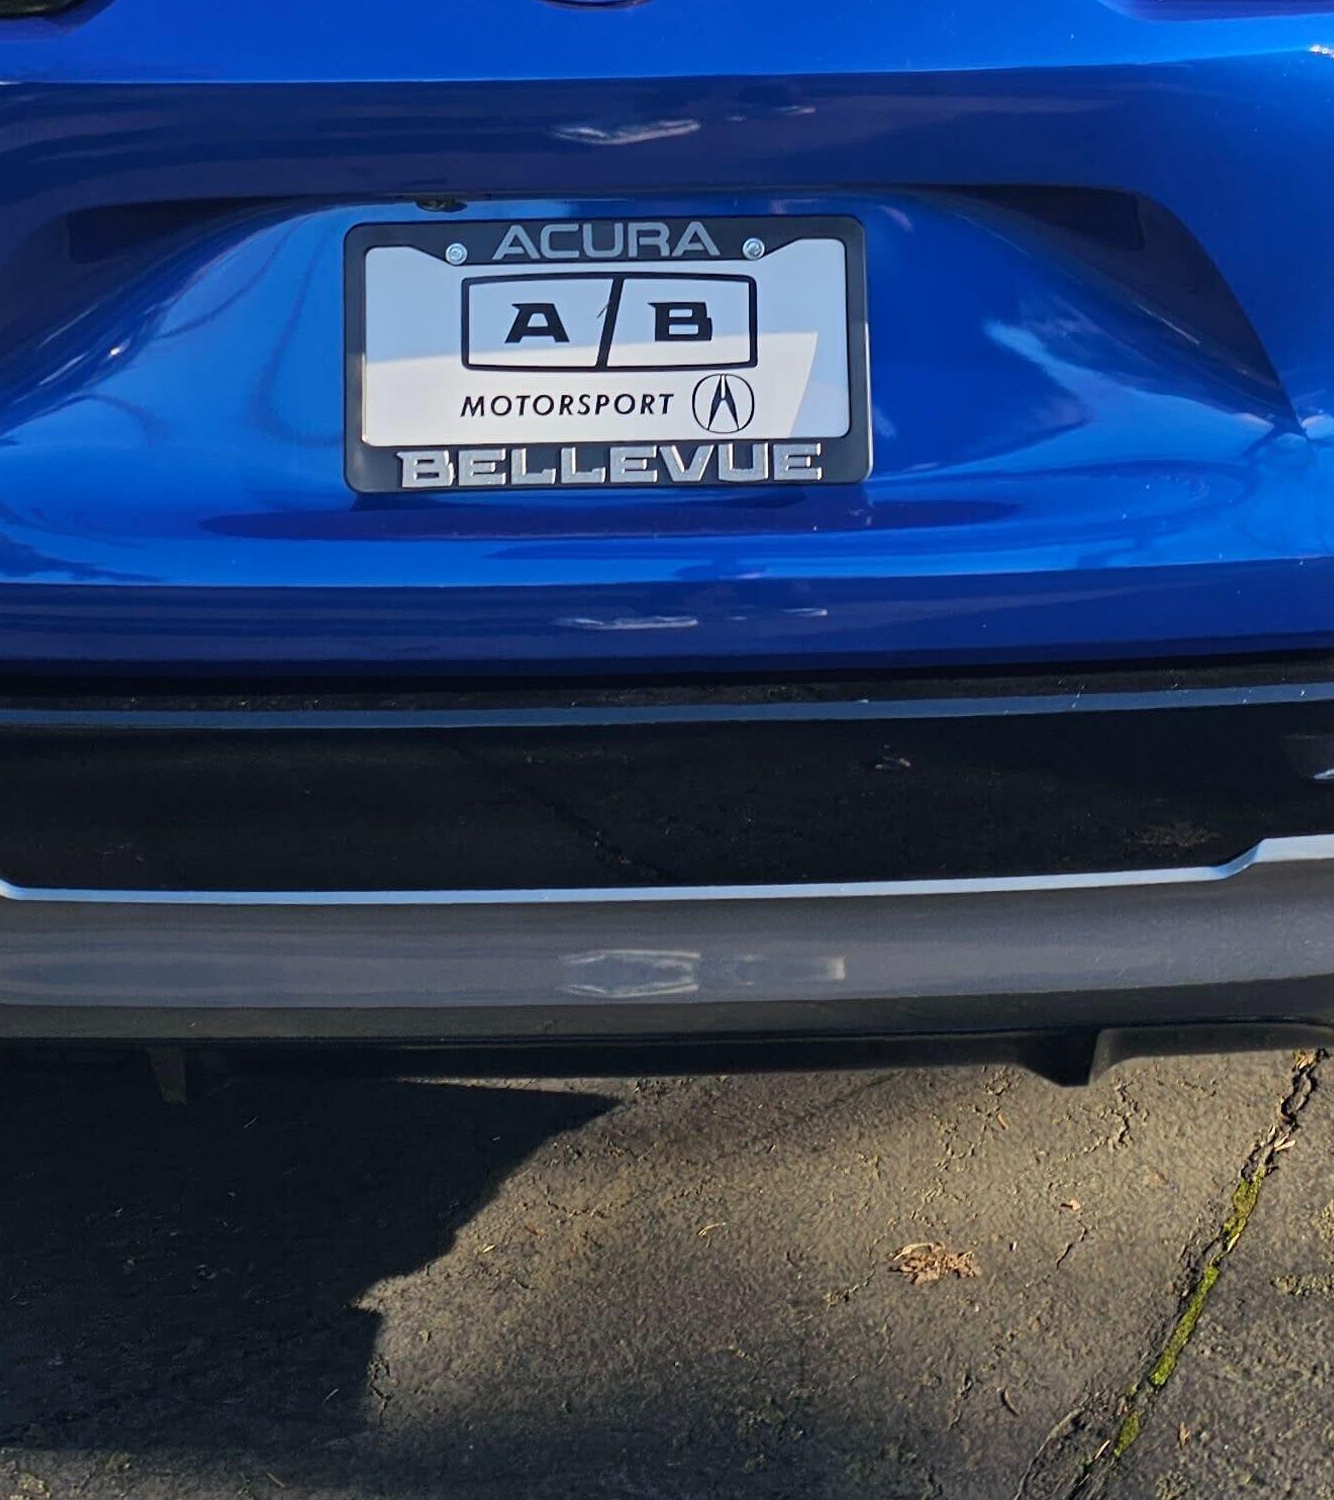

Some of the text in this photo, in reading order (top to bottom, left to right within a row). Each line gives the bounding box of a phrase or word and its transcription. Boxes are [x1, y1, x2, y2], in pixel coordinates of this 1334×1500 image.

[492, 221, 721, 261] ACURA
[460, 392, 675, 419] MOTORSPORT
[397, 442, 824, 488] BELLEVUE
